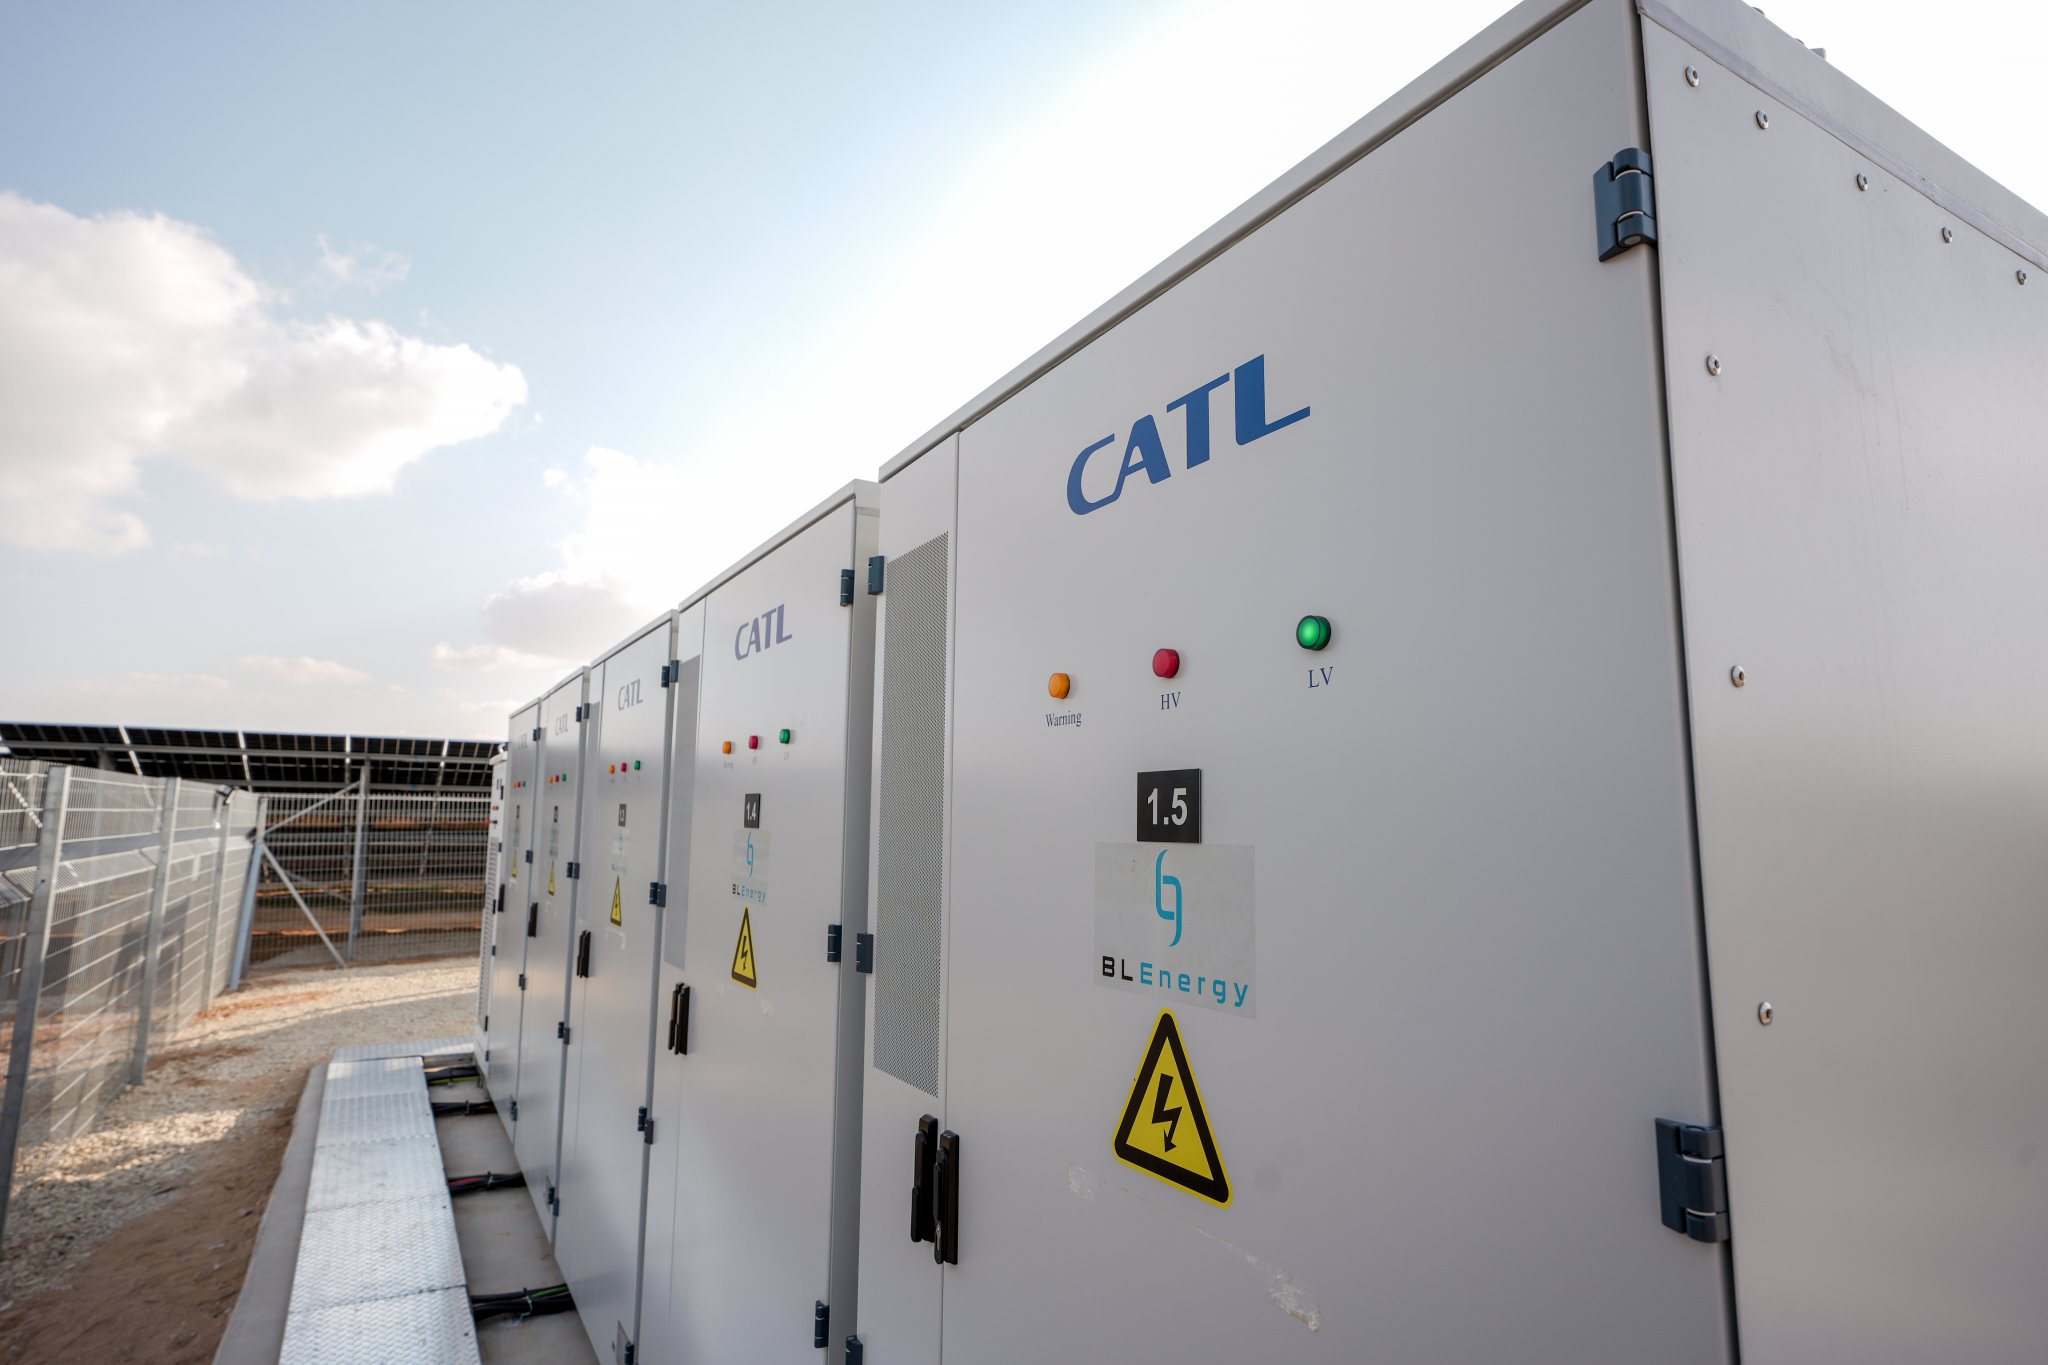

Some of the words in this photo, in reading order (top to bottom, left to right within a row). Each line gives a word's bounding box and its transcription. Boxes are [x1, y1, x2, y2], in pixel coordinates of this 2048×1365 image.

[1066, 353, 1311, 515] CATL
[734, 603, 793, 661] CATL
[1308, 666, 1334, 688] LV
[617, 678, 644, 711] CATL
[1160, 691, 1181, 710] HV
[1045, 710, 1082, 728] Warning
[746, 802, 757, 821] 1.4
[1147, 787, 1188, 826] 1.5
